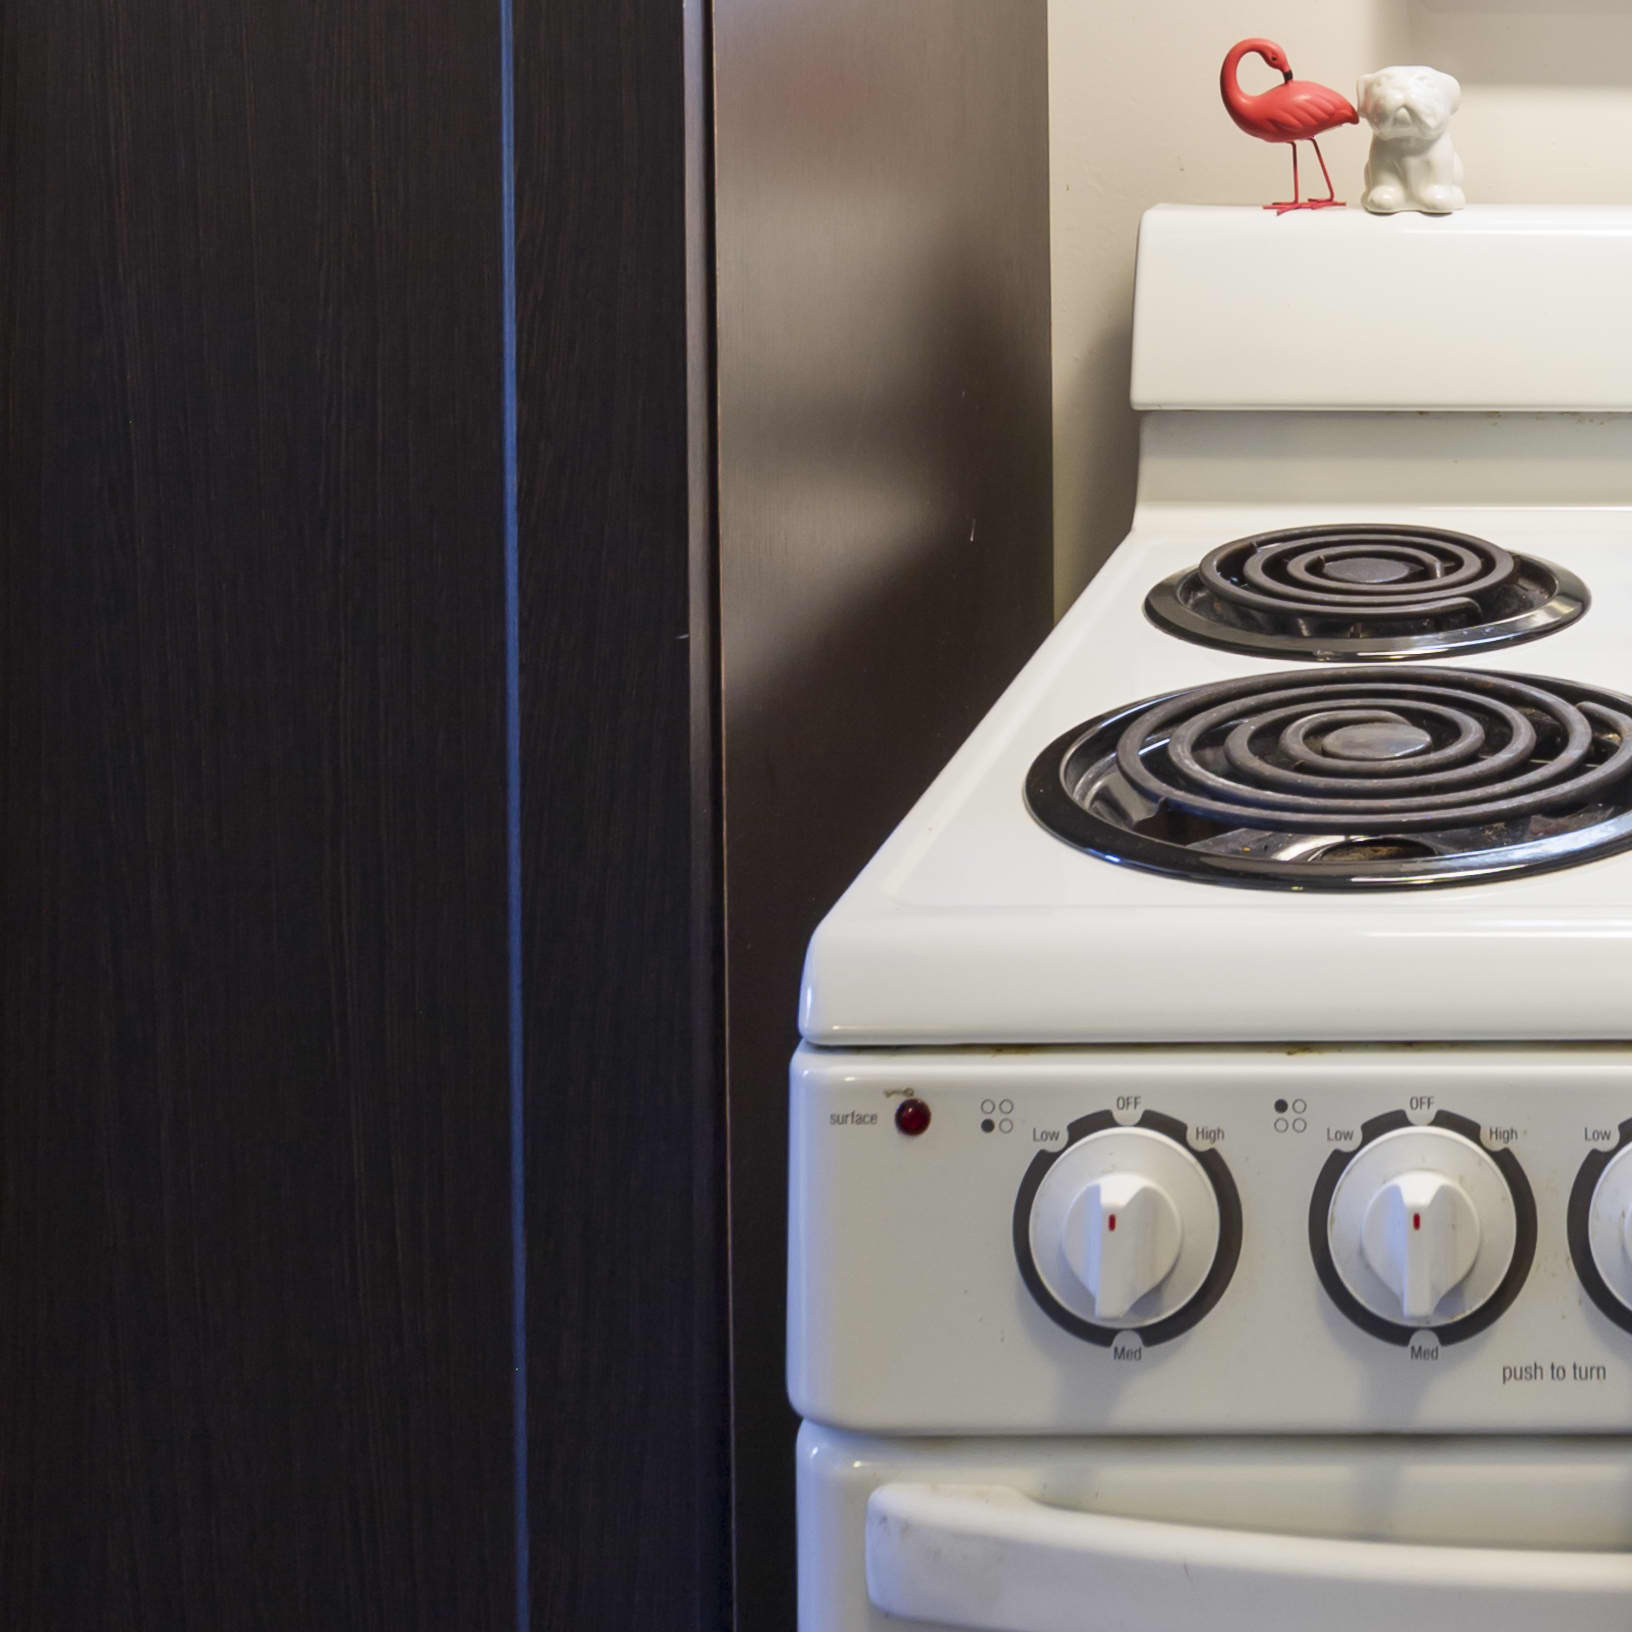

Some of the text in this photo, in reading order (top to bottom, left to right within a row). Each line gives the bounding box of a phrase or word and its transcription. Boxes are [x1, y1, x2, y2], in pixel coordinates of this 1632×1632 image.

[1116, 1095, 1142, 1111] OFF
[1409, 1095, 1436, 1111] OFF
[829, 1110, 878, 1126] surface
[1033, 1126, 1061, 1143] Low
[1195, 1126, 1226, 1144] High
[1326, 1126, 1354, 1143] Low
[1489, 1126, 1519, 1144] High
[1584, 1126, 1612, 1143] Low
[1113, 1345, 1142, 1361] Med
[1410, 1345, 1439, 1361] Med
[1502, 1362, 1607, 1385] push to turn
